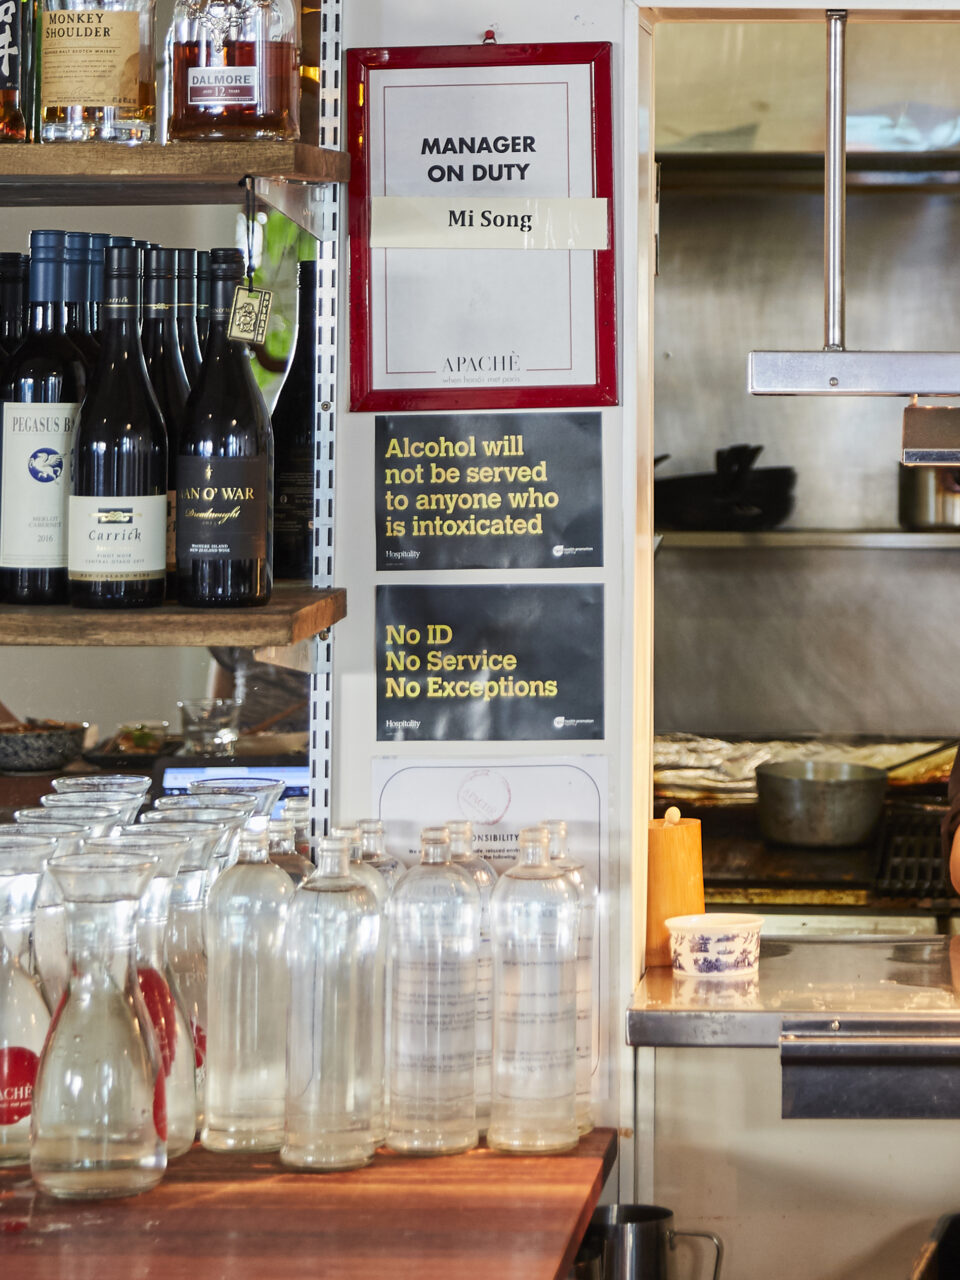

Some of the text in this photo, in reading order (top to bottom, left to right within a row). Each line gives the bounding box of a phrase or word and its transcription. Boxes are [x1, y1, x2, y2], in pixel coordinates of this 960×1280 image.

[49, 13, 104, 24] MONKEY
[46, 27, 111, 38] SHOULDER
[192, 75, 252, 85] DALMORE
[215, 86, 226, 97] 12
[421, 135, 537, 155] MANAGER
[427, 163, 530, 183] ON DUTY
[448, 209, 533, 232] Mi Song
[442, 350, 521, 373] APACHÈ
[12, 416, 60, 433] PEGASUS
[384, 435, 524, 458] Alcohol will
[385, 461, 548, 484] not be served
[221, 487, 256, 500] WAR
[385, 487, 559, 514] to anyone who
[88, 528, 142, 541] Carrick
[386, 514, 543, 536] is intoxicated
[385, 549, 421, 559] Hospitality
[385, 624, 453, 645] No ID
[385, 650, 517, 671] No Service
[385, 676, 558, 701] No Exceptions
[385, 719, 421, 729] Hospitality
